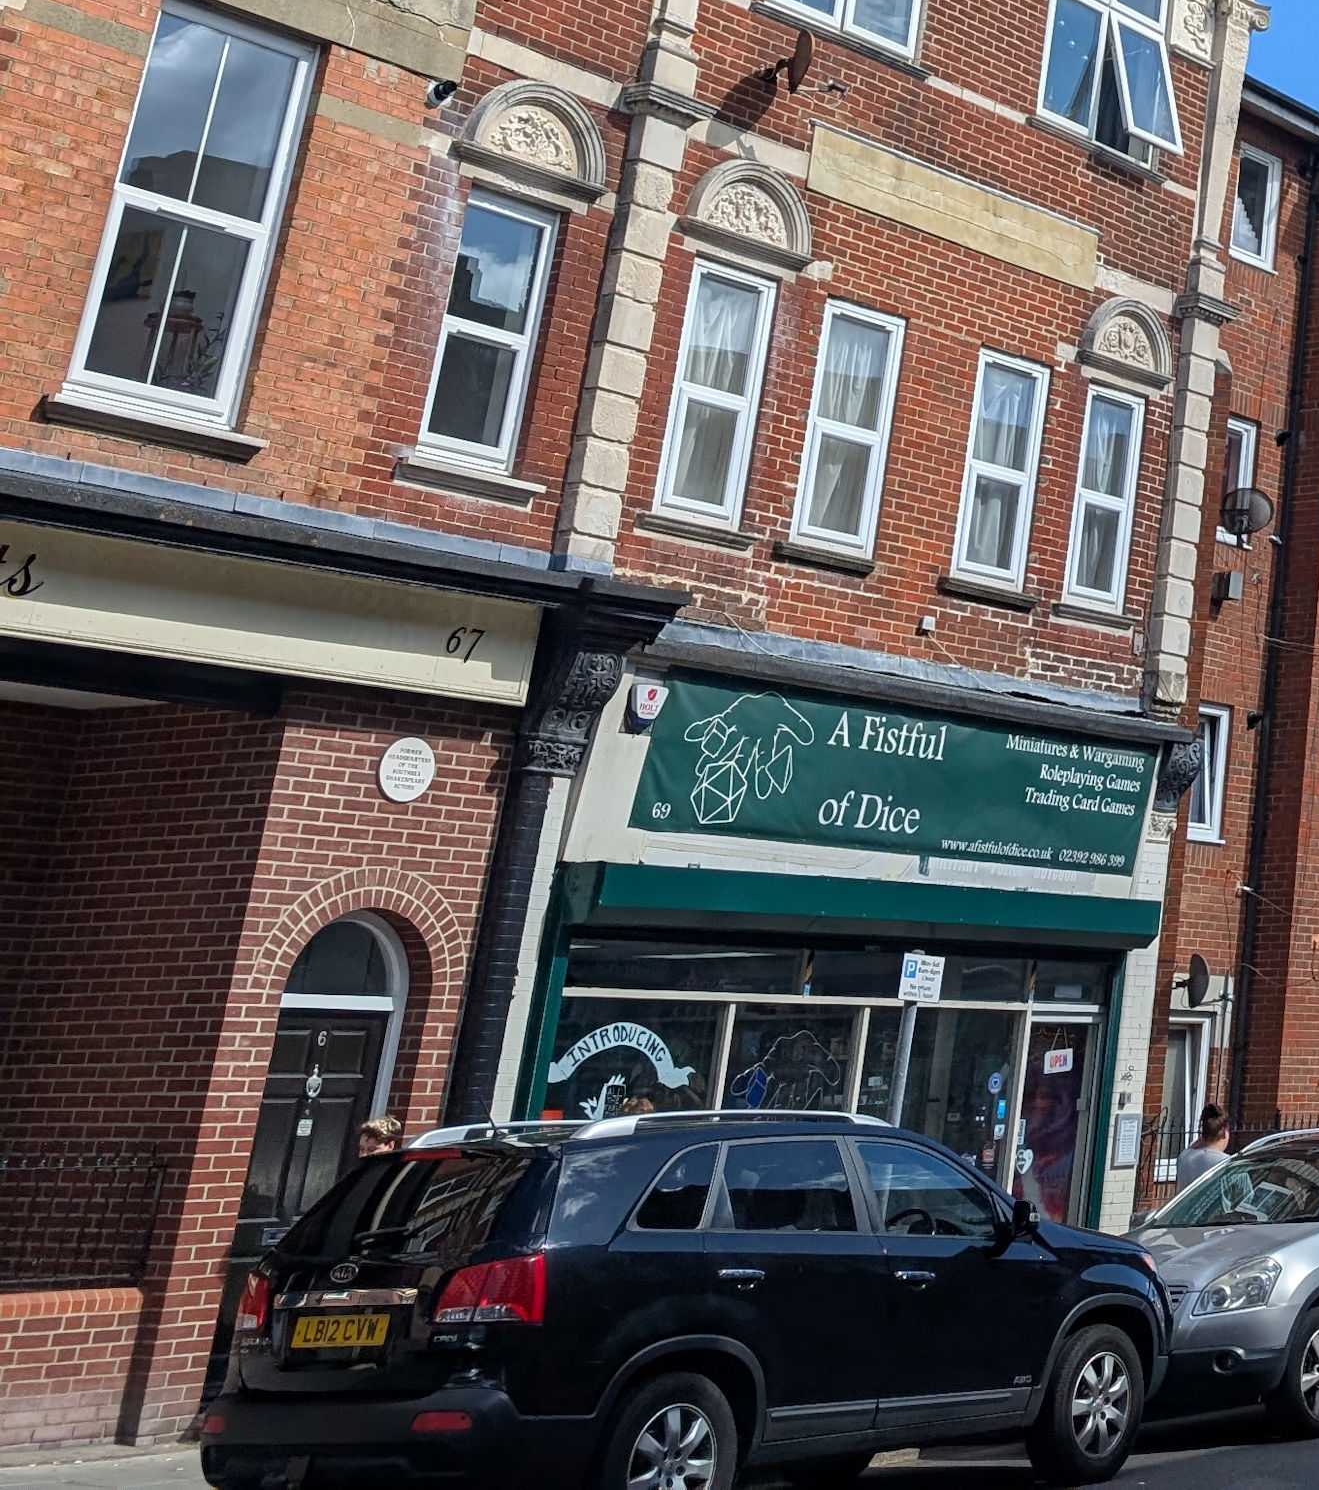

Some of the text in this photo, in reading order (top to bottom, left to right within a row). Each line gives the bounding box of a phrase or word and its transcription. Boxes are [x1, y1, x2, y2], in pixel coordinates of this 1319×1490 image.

[446, 627, 484, 663] 67
[827, 711, 949, 761] A Fistful
[1006, 733, 1145, 773] Miniatures & Wargaming
[1040, 763, 1141, 793] Roleplaying Games
[652, 802, 671, 819] 69
[817, 790, 921, 835] of Dice
[1025, 787, 1135, 816] Trading Card Games
[941, 839, 1125, 868] www.afistfulofdice.co.uk 02392 986 399
[907, 962, 915, 976] P
[317, 1031, 327, 1046] 6
[567, 1025, 666, 1067] INTRODUCING
[1050, 1054, 1068, 1068] OPEN
[302, 1318, 339, 1343] LB12
